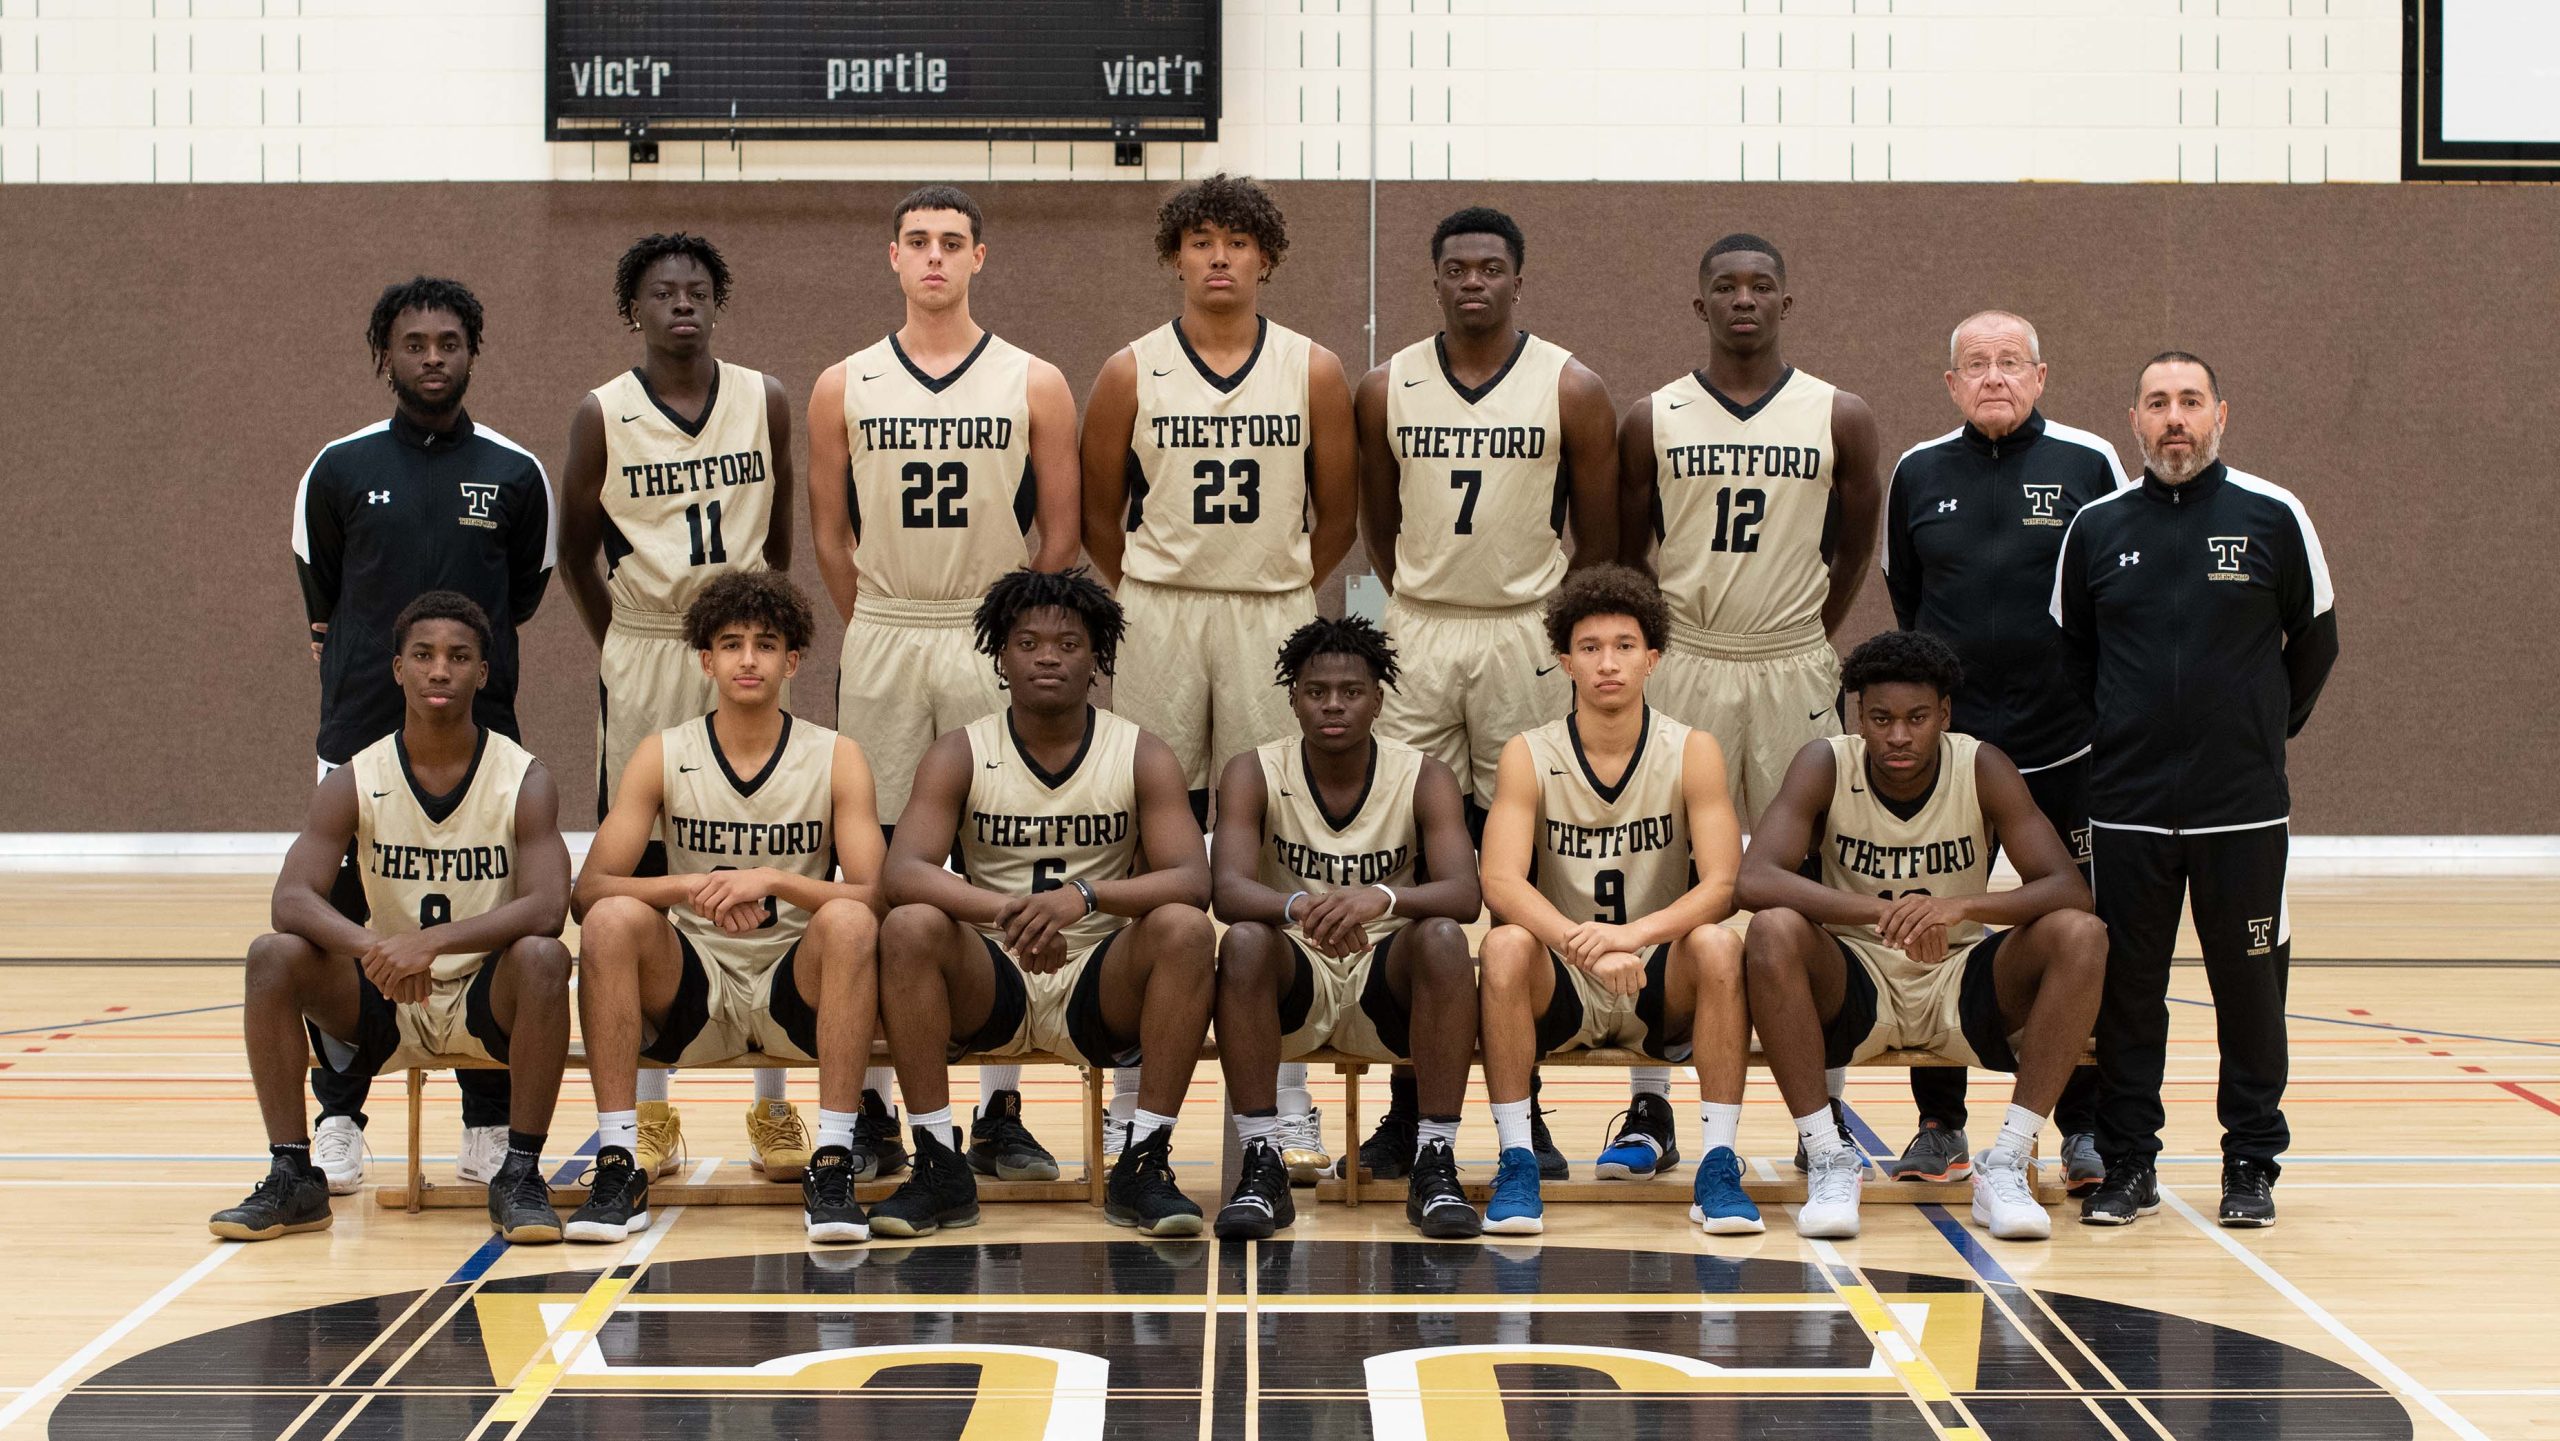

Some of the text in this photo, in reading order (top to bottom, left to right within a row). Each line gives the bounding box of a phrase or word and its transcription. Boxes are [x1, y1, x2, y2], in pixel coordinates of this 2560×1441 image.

[570, 55, 671, 97] vict'r
[827, 51, 947, 100] partie
[1102, 54, 1203, 95] vict'r
[859, 416, 1012, 451] THETFORD
[1151, 414, 1301, 449] THETFORD
[1397, 426, 1546, 460] THETFORD
[622, 450, 766, 498] THETFORD
[1666, 444, 1820, 481] THETFORD
[901, 461, 969, 529] 22
[1193, 458, 1260, 525] 23
[1450, 470, 1482, 535] 7
[685, 500, 727, 567] 11
[1710, 487, 1766, 553] 12
[672, 815, 823, 857] THETFORD
[973, 811, 1129, 848] THETFORD
[1545, 812, 1674, 859] THETFORD
[1273, 834, 1408, 886] THETFORD
[1835, 833, 1976, 880] THETFORD
[1593, 868, 1628, 926] 9
